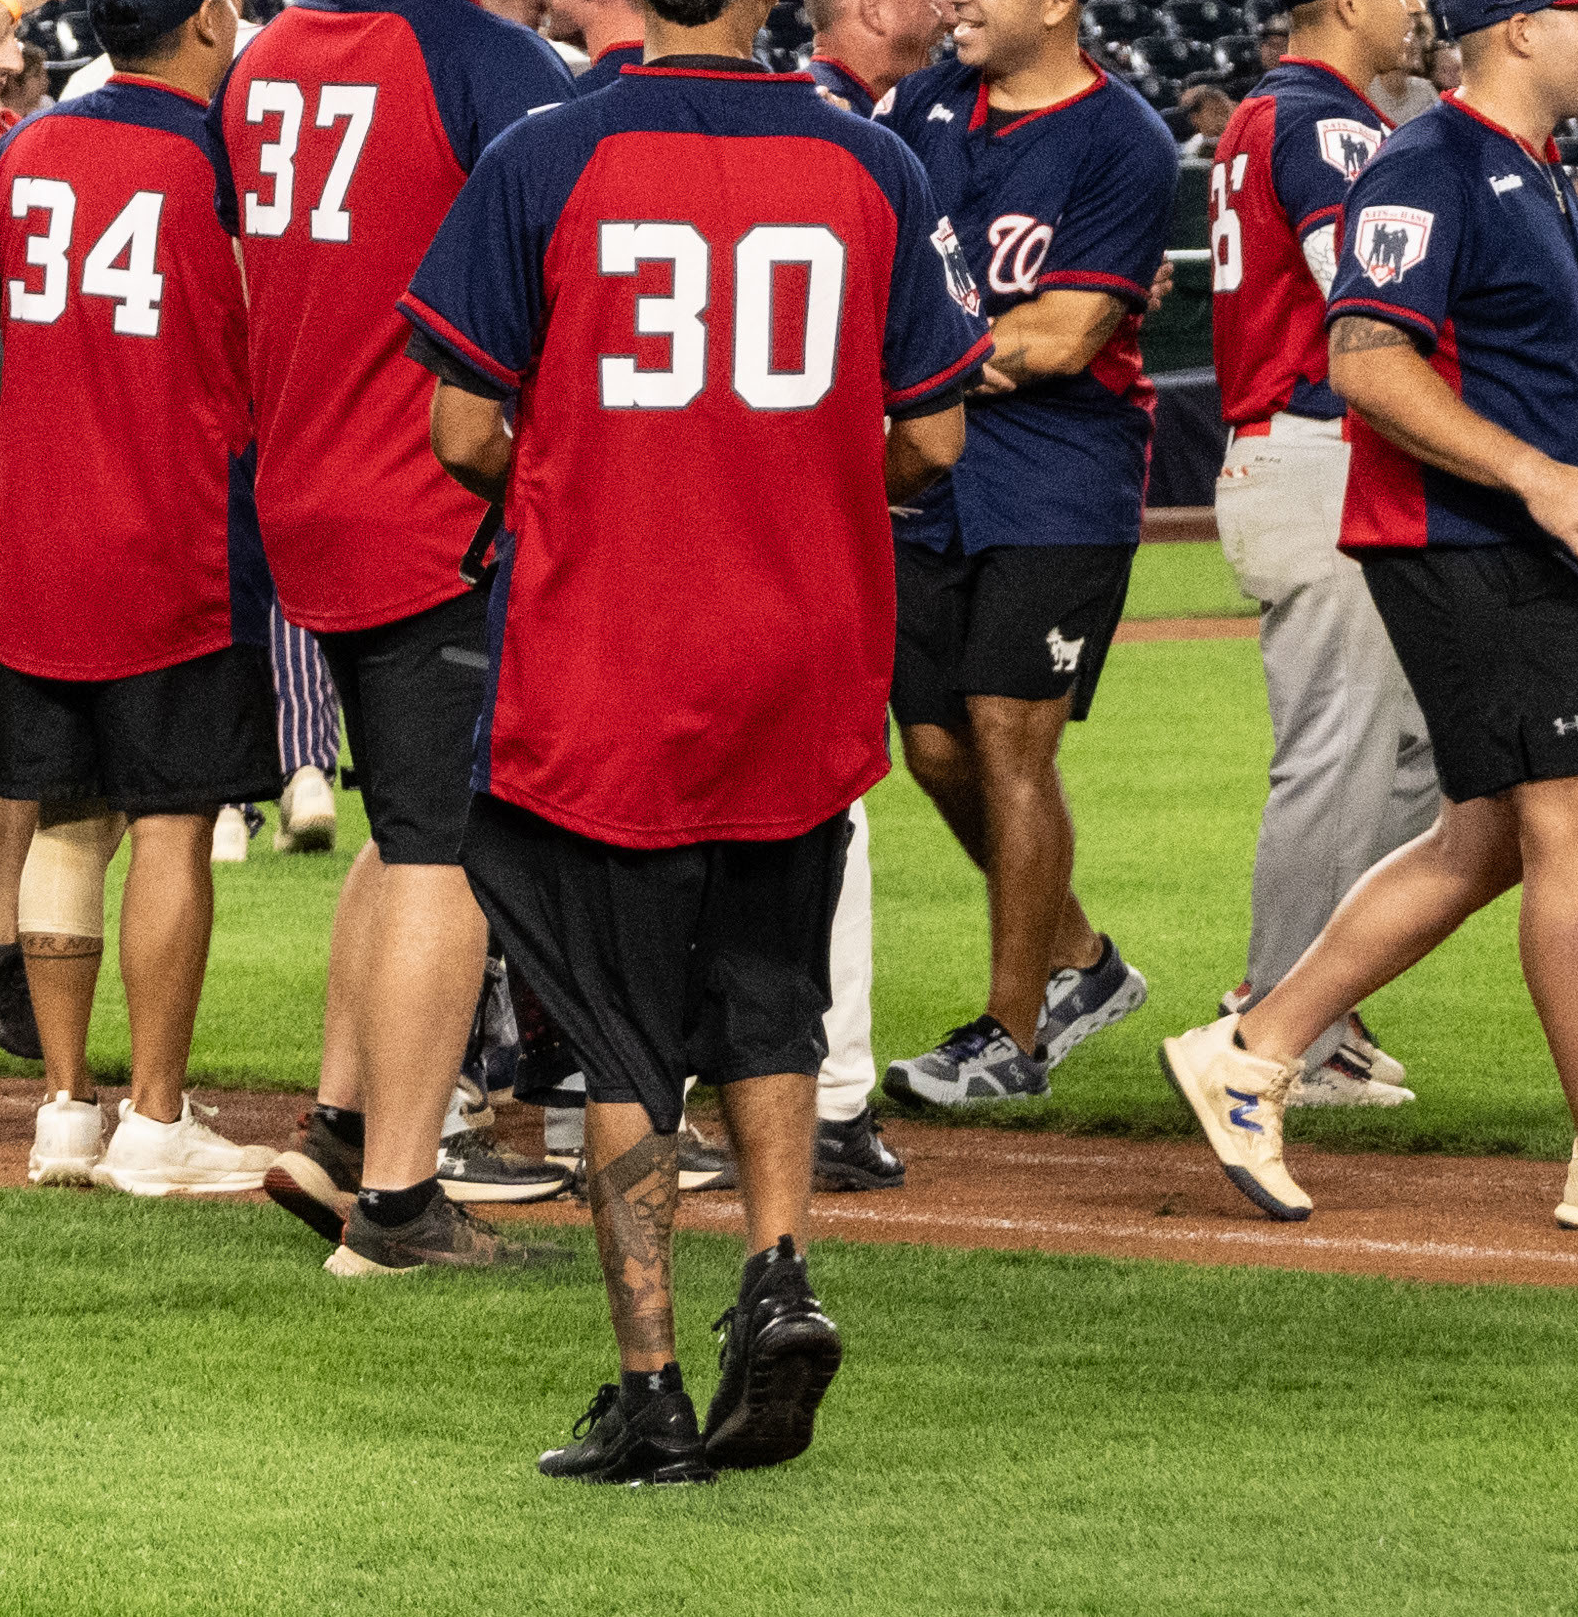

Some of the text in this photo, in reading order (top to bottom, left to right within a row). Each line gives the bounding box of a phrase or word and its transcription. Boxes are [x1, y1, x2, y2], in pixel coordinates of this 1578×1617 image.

[245, 79, 378, 244] 37
[9, 177, 164, 338] 34
[597, 220, 848, 412] 30
[987, 213, 1054, 294] W
